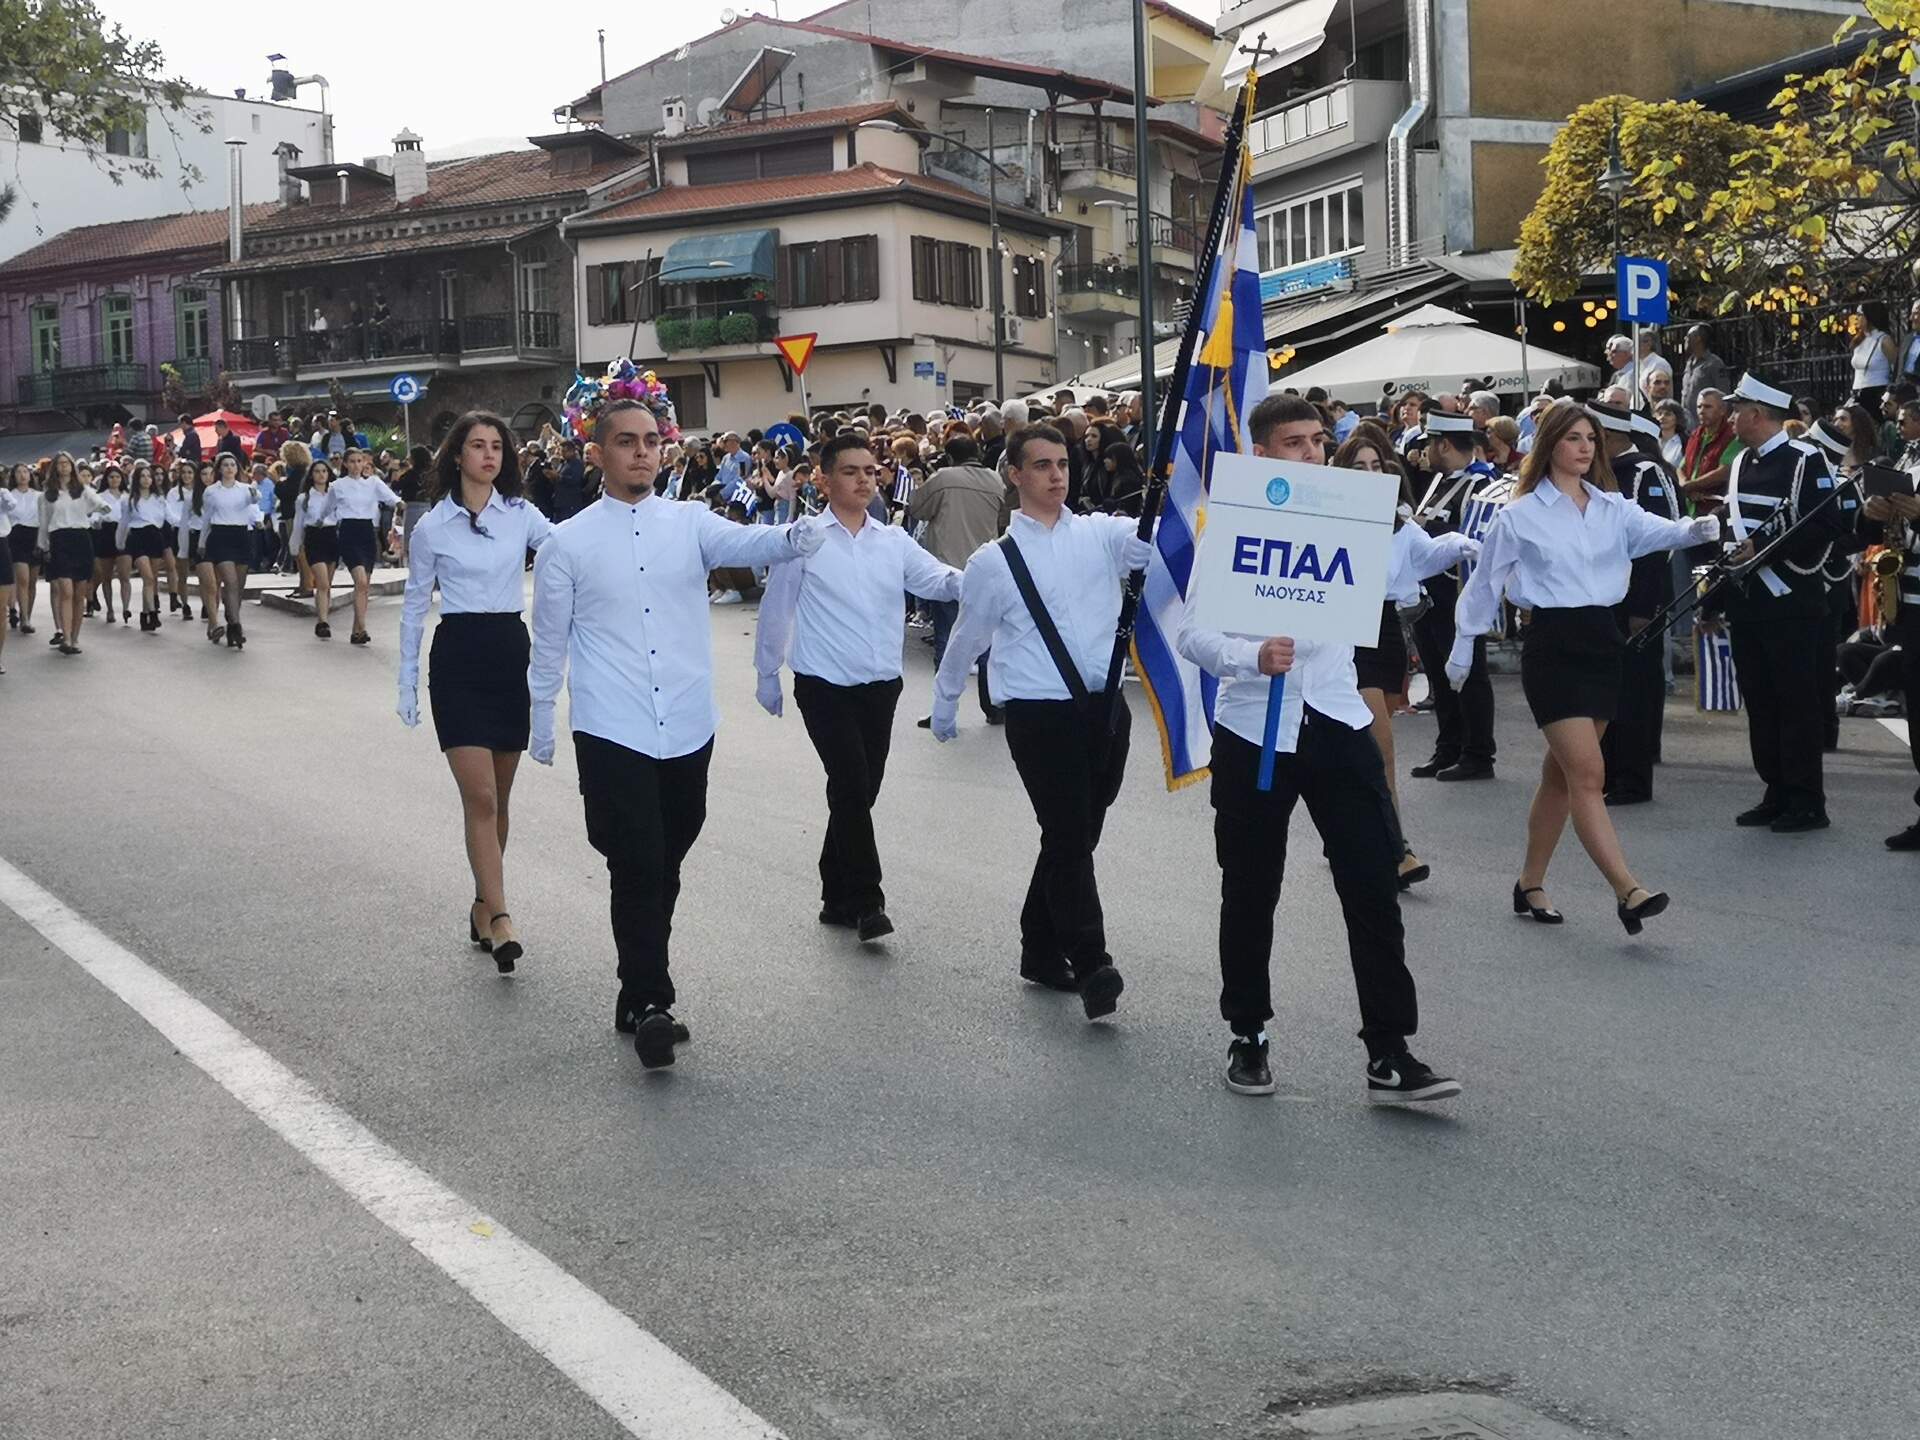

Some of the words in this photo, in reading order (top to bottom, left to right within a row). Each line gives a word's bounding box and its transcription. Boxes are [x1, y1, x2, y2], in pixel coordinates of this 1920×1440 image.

[1627, 265, 1660, 316] P
[1232, 535, 1354, 586] ΕΠΑΛ
[1255, 584, 1326, 604] ΝΑΟΥΣΑΣ
